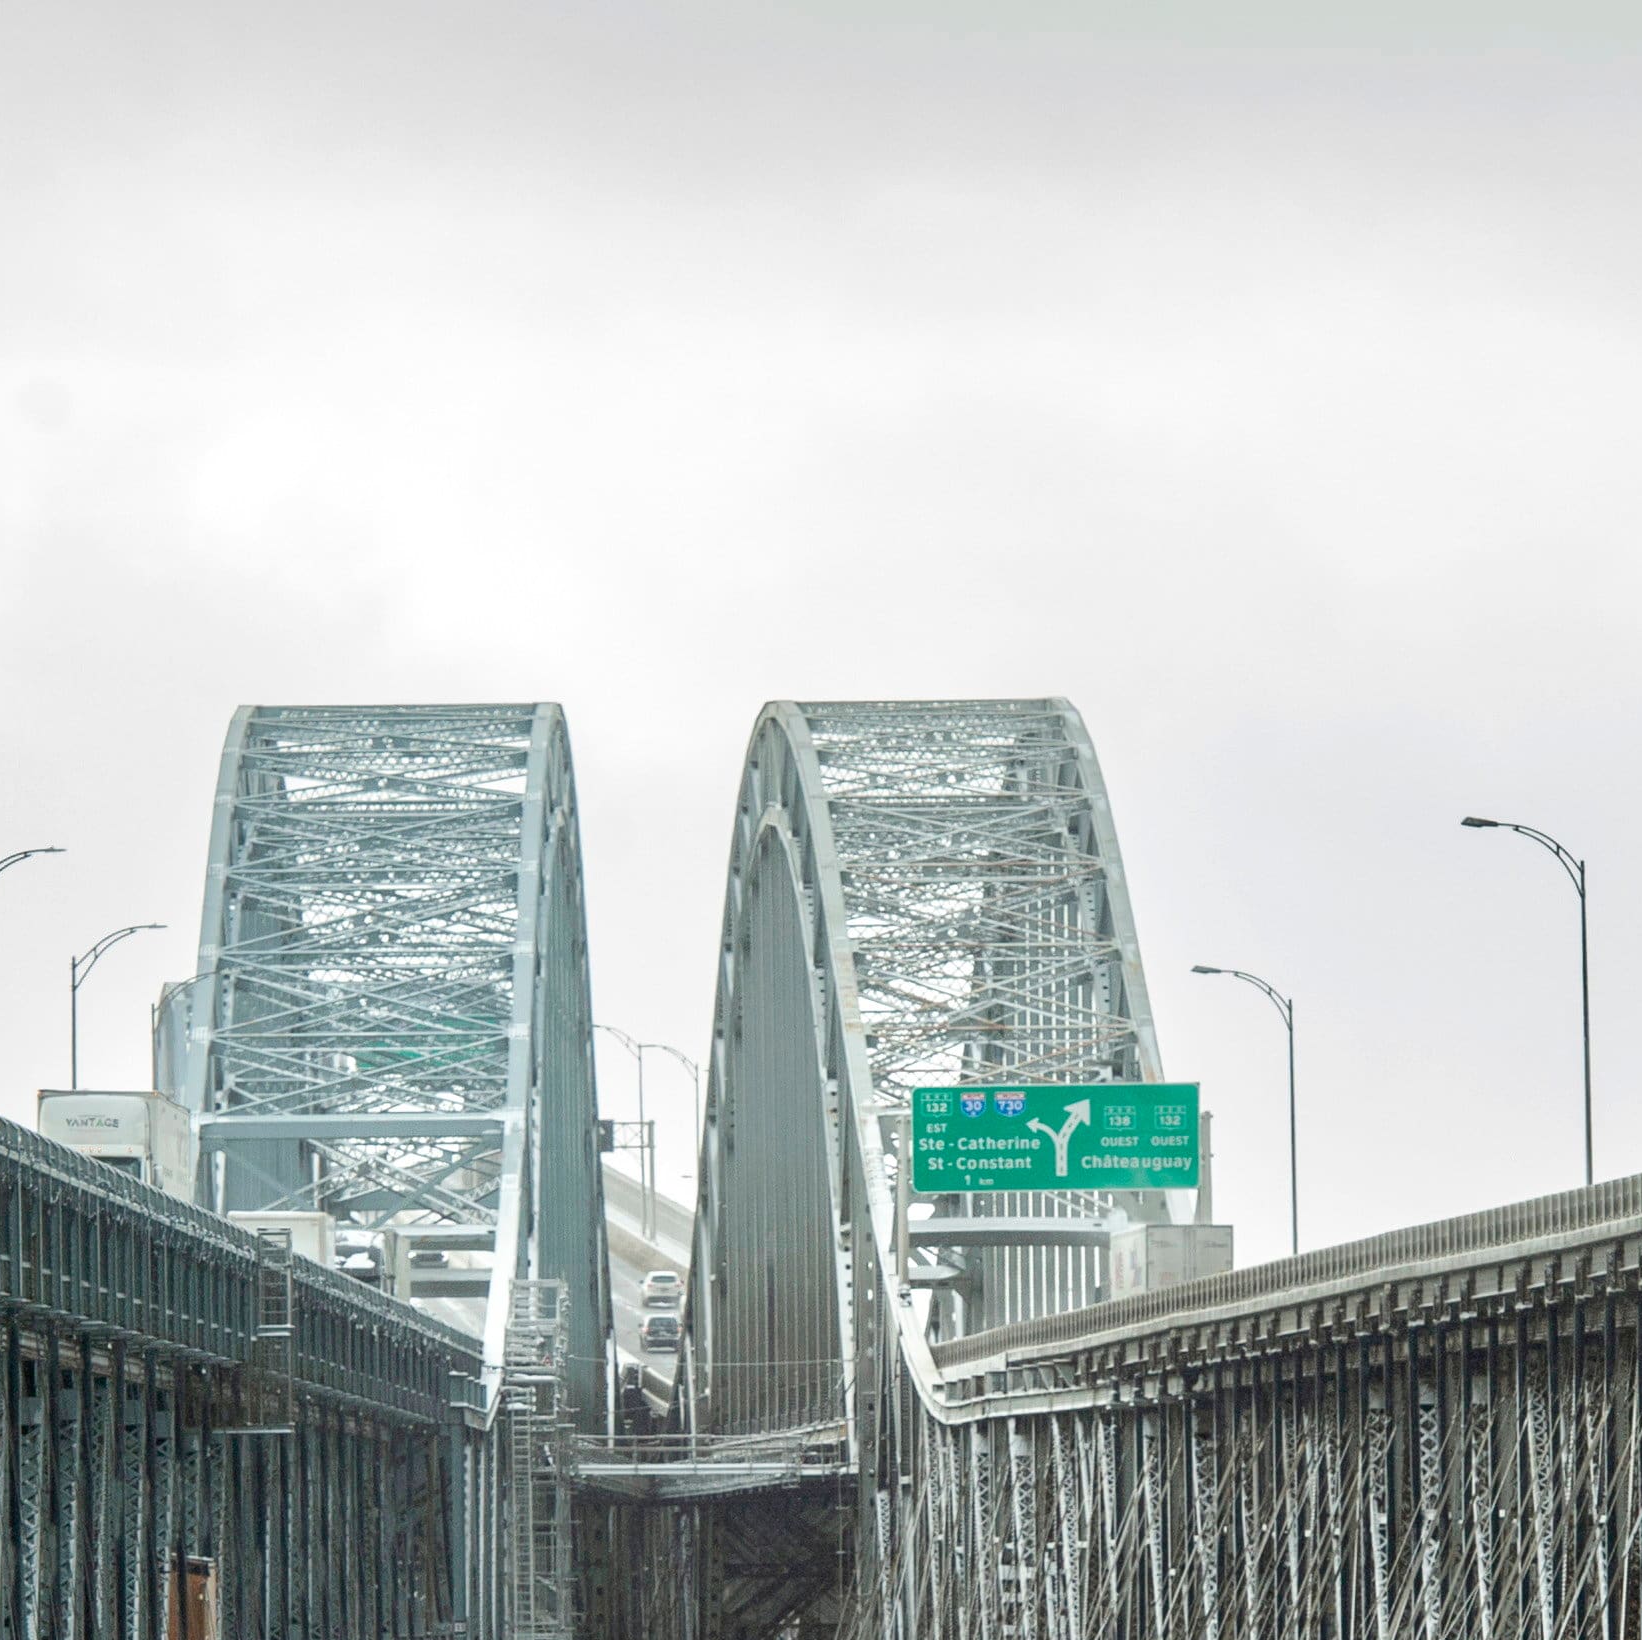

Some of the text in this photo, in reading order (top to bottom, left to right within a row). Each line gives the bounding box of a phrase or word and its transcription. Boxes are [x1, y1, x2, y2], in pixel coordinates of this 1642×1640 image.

[926, 1101, 1024, 1113] 132 30 730
[65, 1118, 120, 1128] VANTAGE
[1160, 1115, 1182, 1126] 132
[926, 1123, 948, 1133] EST
[1100, 1135, 1189, 1147] OUEST OUEST
[1081, 1154, 1192, 1172] Châteauguay
[964, 1175, 971, 1186] 1
